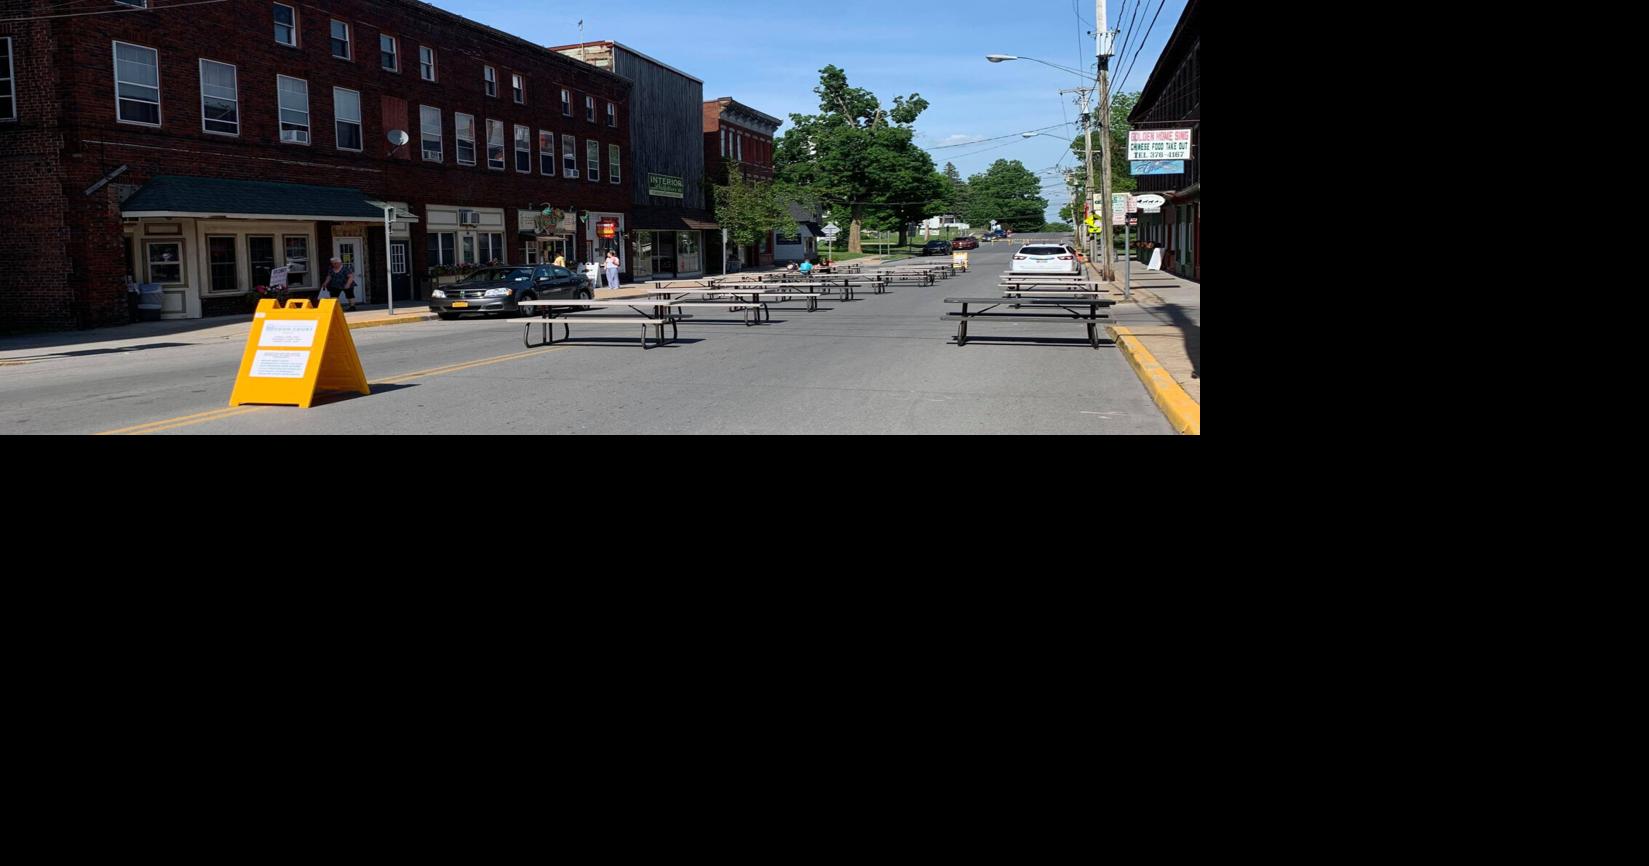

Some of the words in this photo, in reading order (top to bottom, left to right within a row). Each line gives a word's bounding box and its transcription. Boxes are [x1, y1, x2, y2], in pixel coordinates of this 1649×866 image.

[1131, 132, 1154, 141] GOLDEN
[1130, 142, 1150, 151] CHINESE
[1152, 142, 1164, 150] FOOD
[1166, 142, 1177, 150] TAKE
[1179, 141, 1188, 150] OUT
[650, 176, 683, 187] INTERIOR
